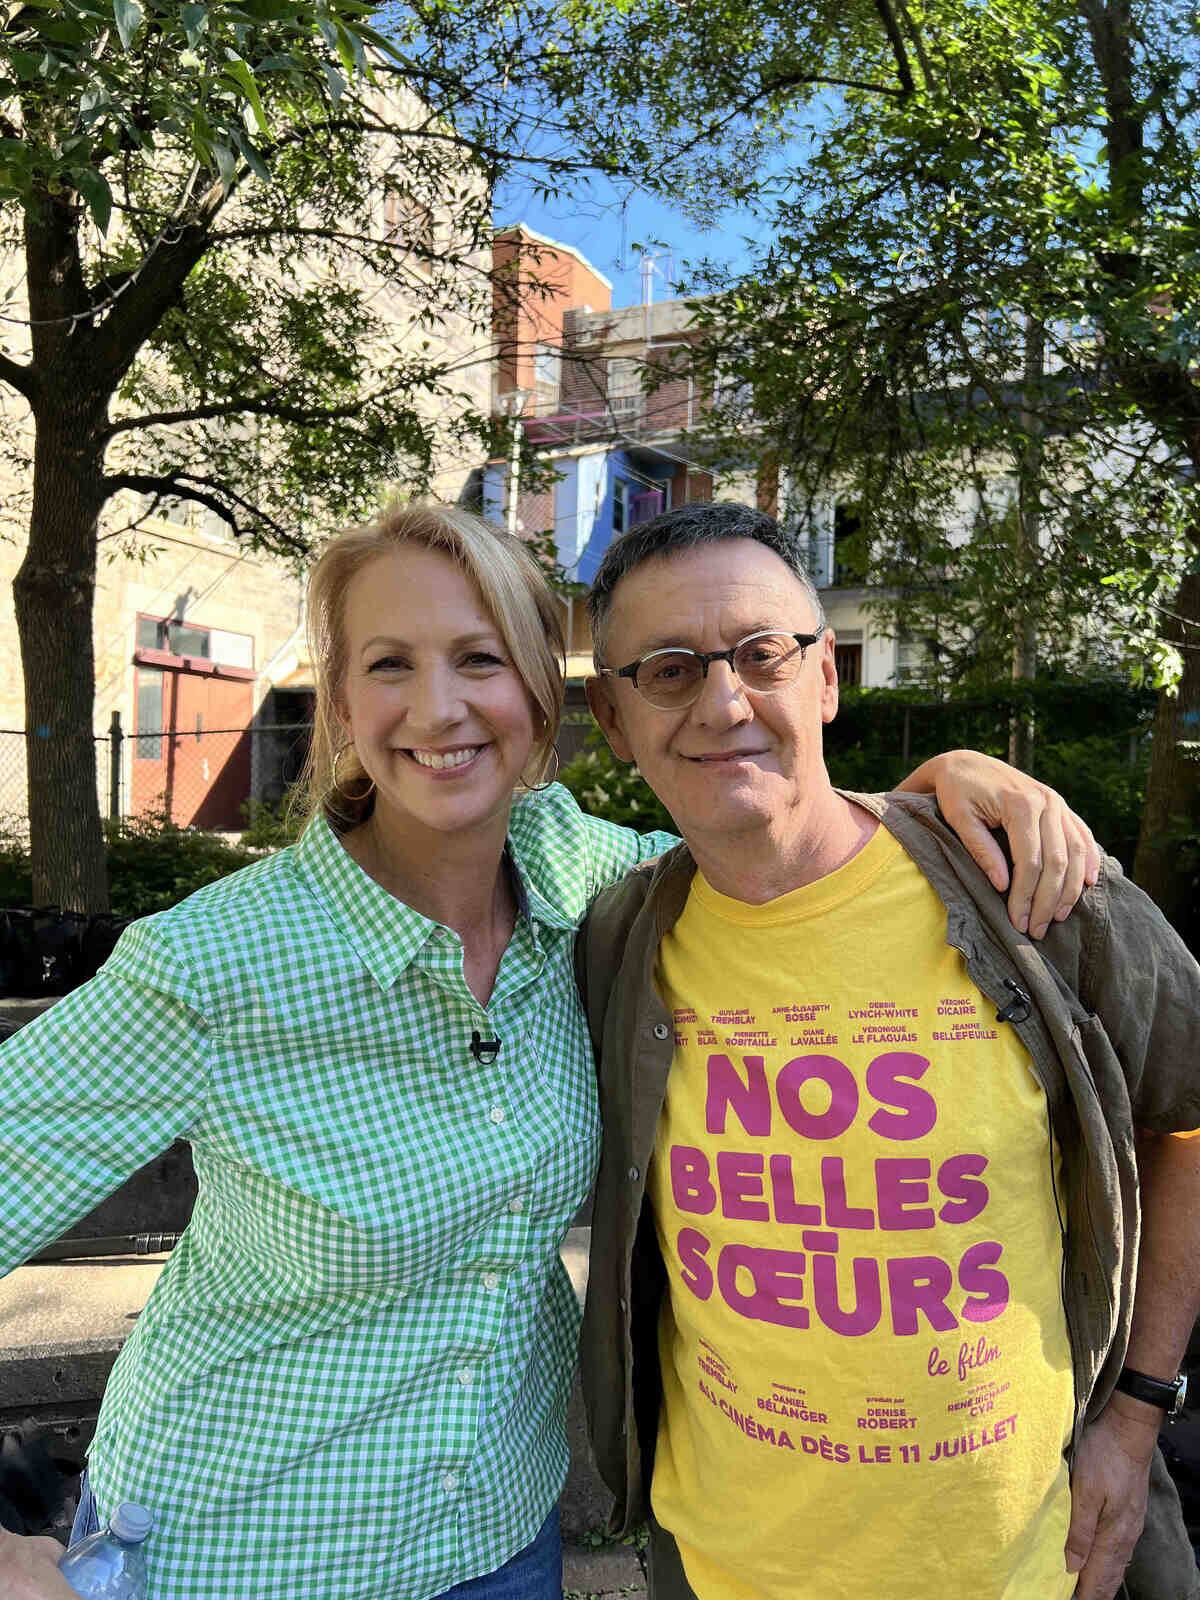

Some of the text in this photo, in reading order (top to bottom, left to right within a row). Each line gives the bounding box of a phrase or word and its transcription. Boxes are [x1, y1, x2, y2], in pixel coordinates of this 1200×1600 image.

[848, 1008, 918, 1019] LYNCH-WHITE
[937, 1006, 976, 1016] DICAIRE
[711, 1015, 756, 1025] TREMBLAY
[803, 1028, 824, 1036] DIANE
[932, 1031, 998, 1041] BELLEFEUILLE
[725, 1038, 777, 1047] ROBITAILLE
[790, 1033, 838, 1046] LAVALLÉE
[852, 1034, 865, 1044] LE
[705, 1051, 938, 1141] NOS
[670, 1144, 989, 1231] BELLES
[927, 1336, 1001, 1381] le film
[772, 1393, 808, 1409] DANIEL
[757, 1397, 828, 1424] BÉLANGER
[867, 1408, 907, 1417] DENISE
[970, 1401, 994, 1417] CYR
[857, 1418, 918, 1429] ROBERT
[719, 1399, 796, 1450] CINÉMA
[801, 1435, 850, 1464] DÈS
[858, 1444, 892, 1464] LE
[900, 1444, 921, 1464] 11
[929, 1414, 1018, 1461] JUILLET
